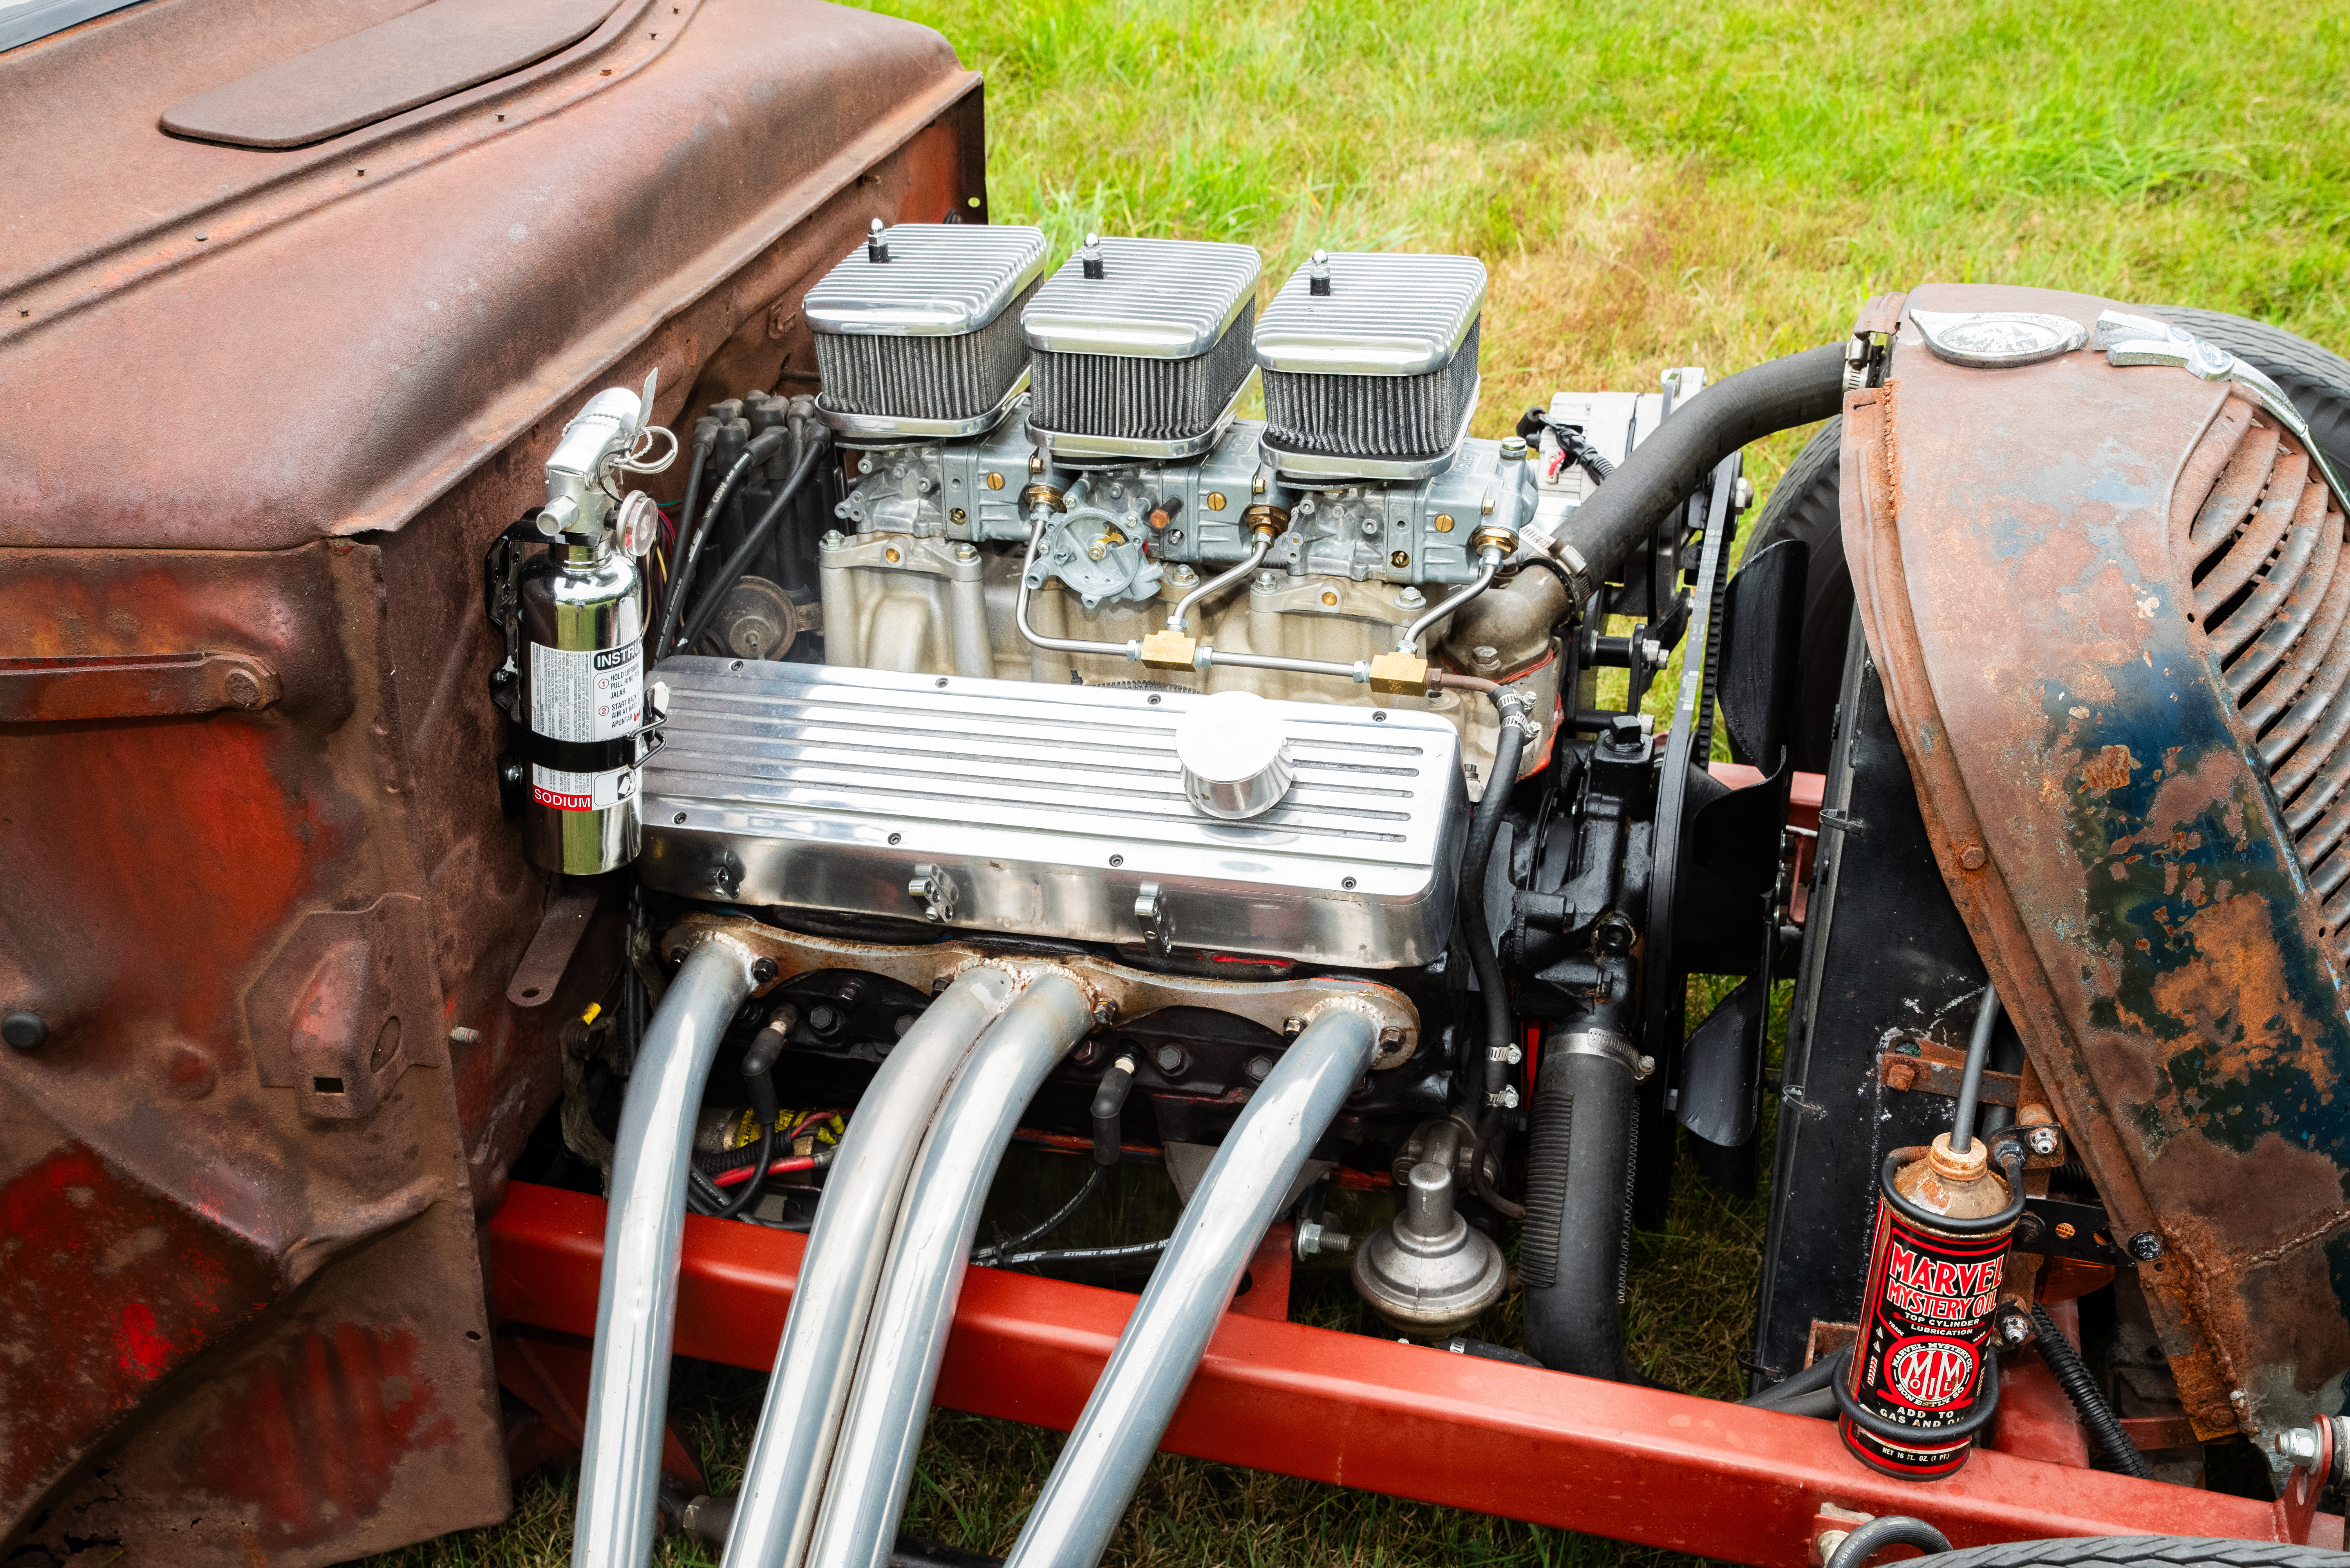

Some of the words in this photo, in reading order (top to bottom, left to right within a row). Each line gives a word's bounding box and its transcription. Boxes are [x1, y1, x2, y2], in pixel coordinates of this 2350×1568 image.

[733, 453, 750, 470] WIRE
[712, 481, 727, 502] MSD
[669, 577, 682, 612] STREET
[662, 614, 670, 634] FIRE
[611, 672, 624, 681] HOLD
[625, 661, 639, 676] UPRIGHT
[611, 680, 623, 690] PULL
[624, 674, 633, 685] RING
[611, 688, 627, 699] JALAR.
[612, 700, 627, 711] START
[628, 694, 636, 704] BACK
[612, 710, 621, 719] AIM
[535, 789, 590, 807] SODIUM
[1889, 1241, 2005, 1296] MARVEL
[1887, 1277, 1975, 1320] MYSTERY
[1972, 1289, 1997, 1317] OIL
[1905, 1312, 1925, 1322] TOP
[1929, 1319, 1979, 1327] CYLINDER
[1889, 1321, 1904, 1336] TRADE
[1911, 1324, 1973, 1335] LUBRICATION
[1973, 1331, 1986, 1342] MARK
[1892, 1343, 1925, 1367] MARVEL
[1928, 1342, 1969, 1358] MYSTERY
[1896, 1384, 1950, 1407] HONESTLY
[1954, 1387, 1964, 1398] SO
[1880, 1409, 1906, 1423] GAS
[1897, 1407, 1925, 1418] ADD
[1883, 1447, 1894, 1456] NET
